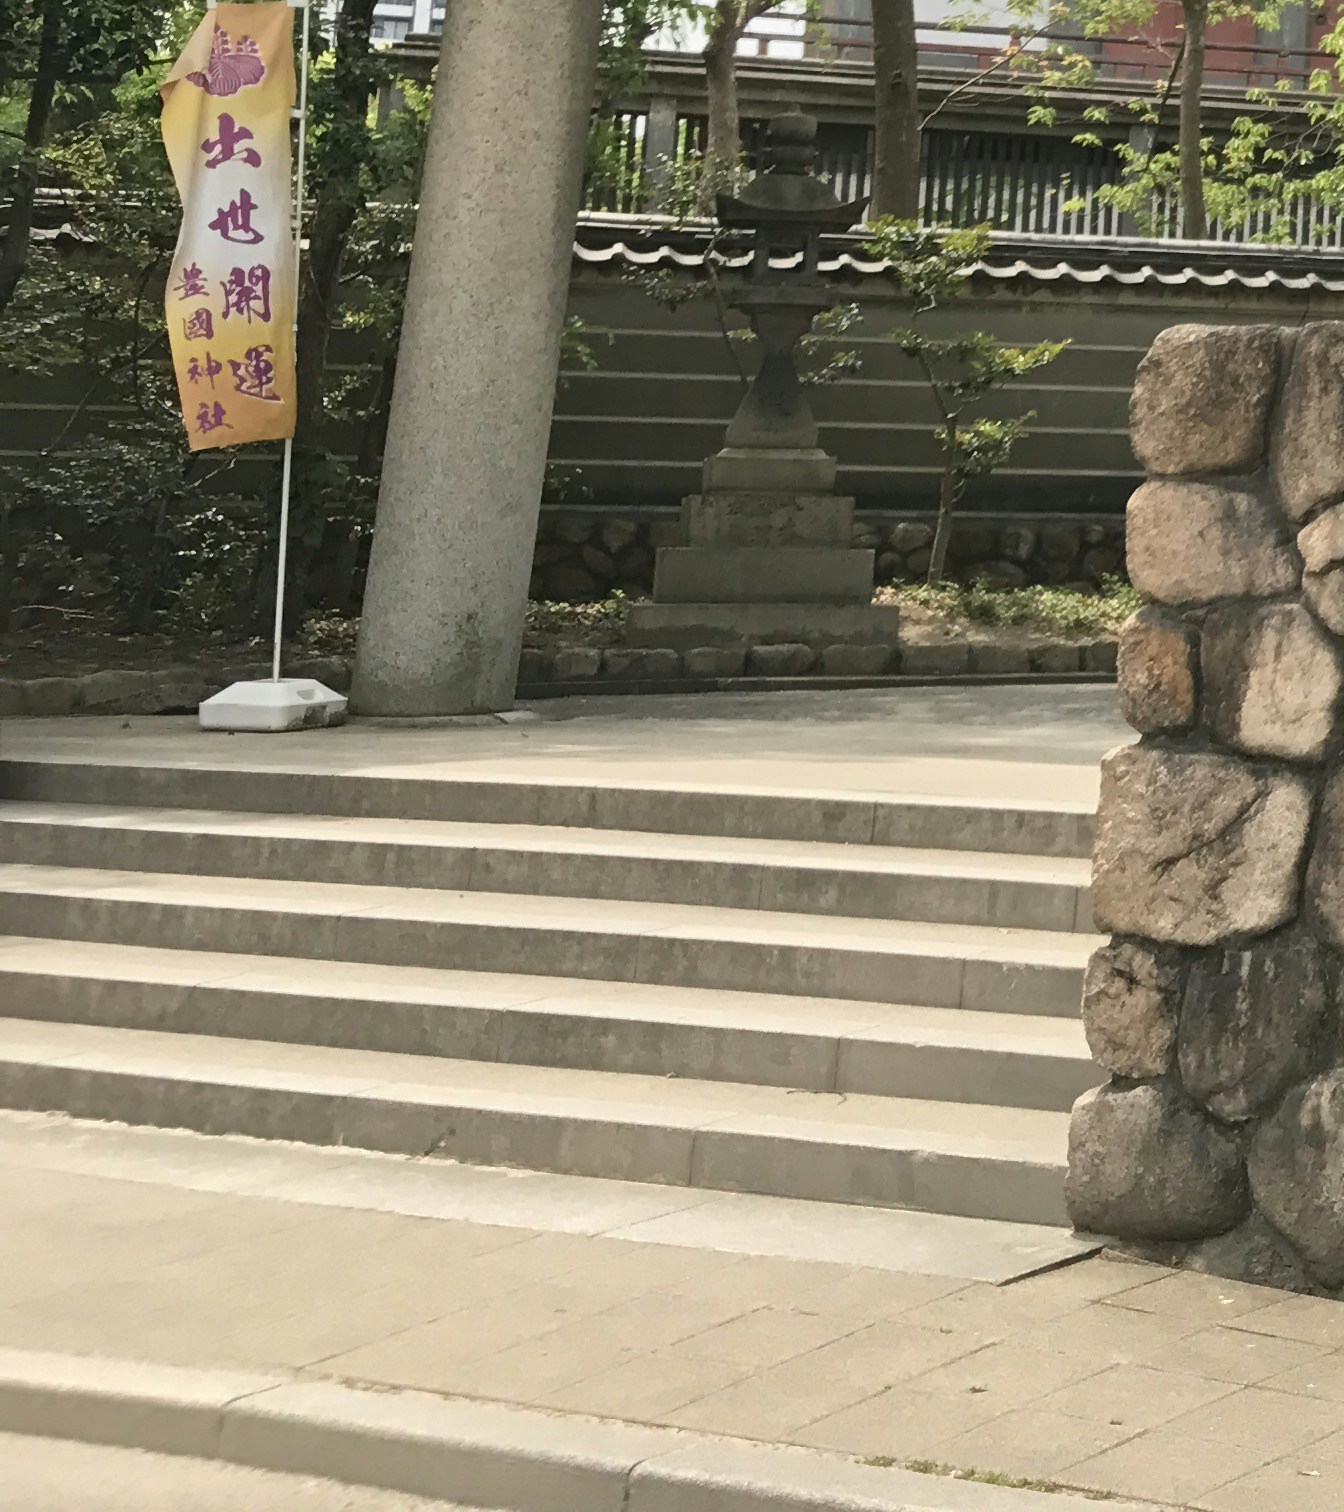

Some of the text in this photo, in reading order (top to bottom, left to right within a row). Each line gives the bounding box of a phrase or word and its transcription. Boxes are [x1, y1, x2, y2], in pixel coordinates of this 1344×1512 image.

[173, 261, 234, 435] 豊國神社
[200, 111, 285, 403] 出世開運
